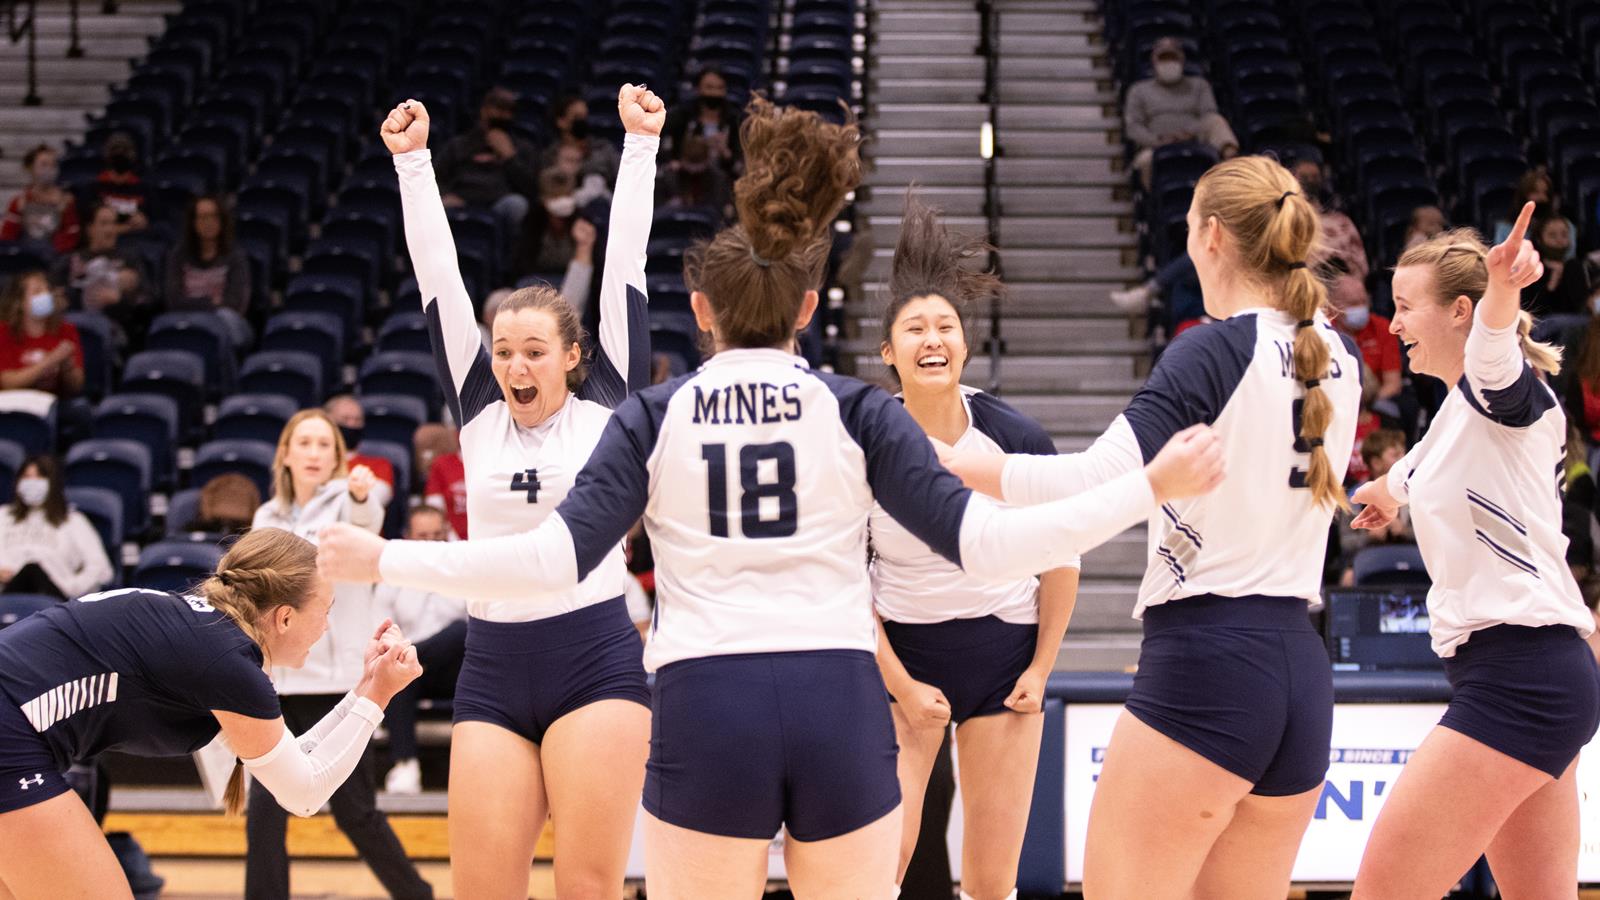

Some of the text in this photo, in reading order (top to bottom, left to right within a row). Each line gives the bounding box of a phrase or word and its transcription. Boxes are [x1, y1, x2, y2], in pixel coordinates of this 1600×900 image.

[692, 382, 802, 425] MINES
[510, 468, 541, 504] 4
[701, 441, 798, 538] 18
[1343, 749, 1392, 764] SINCE
